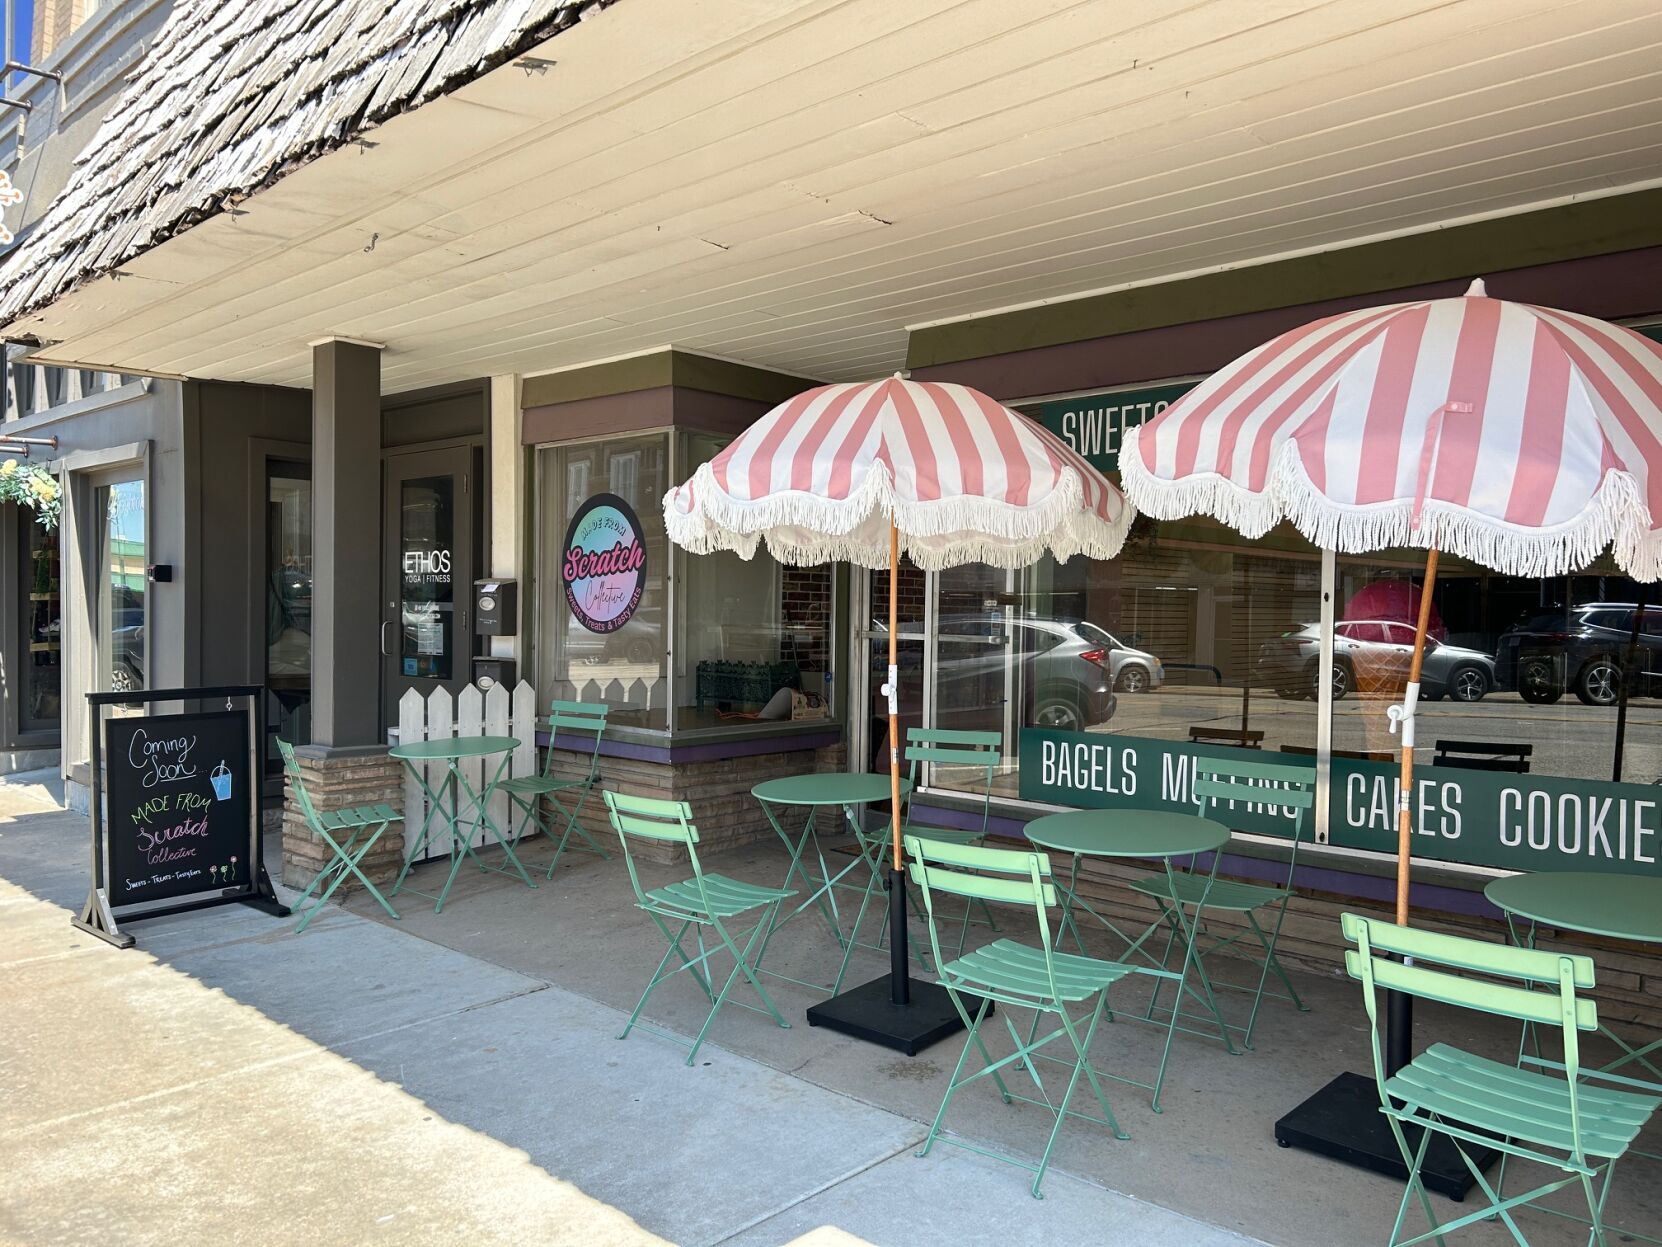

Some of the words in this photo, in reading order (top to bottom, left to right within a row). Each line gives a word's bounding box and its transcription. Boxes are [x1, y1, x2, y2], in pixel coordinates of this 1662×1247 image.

[1062, 400, 1169, 456] SWEET
[604, 516, 627, 537] FROM
[405, 550, 451, 573] ETHOS
[405, 574, 421, 583] YOGA
[427, 574, 451, 583] FITNESS
[563, 540, 646, 581] Scratch
[584, 616, 605, 631] Treats
[607, 621, 613, 630] &
[613, 608, 631, 627] Tasty
[629, 586, 642, 609] Eats
[585, 580, 625, 614] Collective
[128, 728, 197, 769] Coming
[1042, 740, 1137, 796] BAGELS
[131, 795, 170, 825] MADE
[175, 792, 212, 814] FROM
[136, 814, 209, 852] Scratch
[147, 846, 197, 865] Collective
